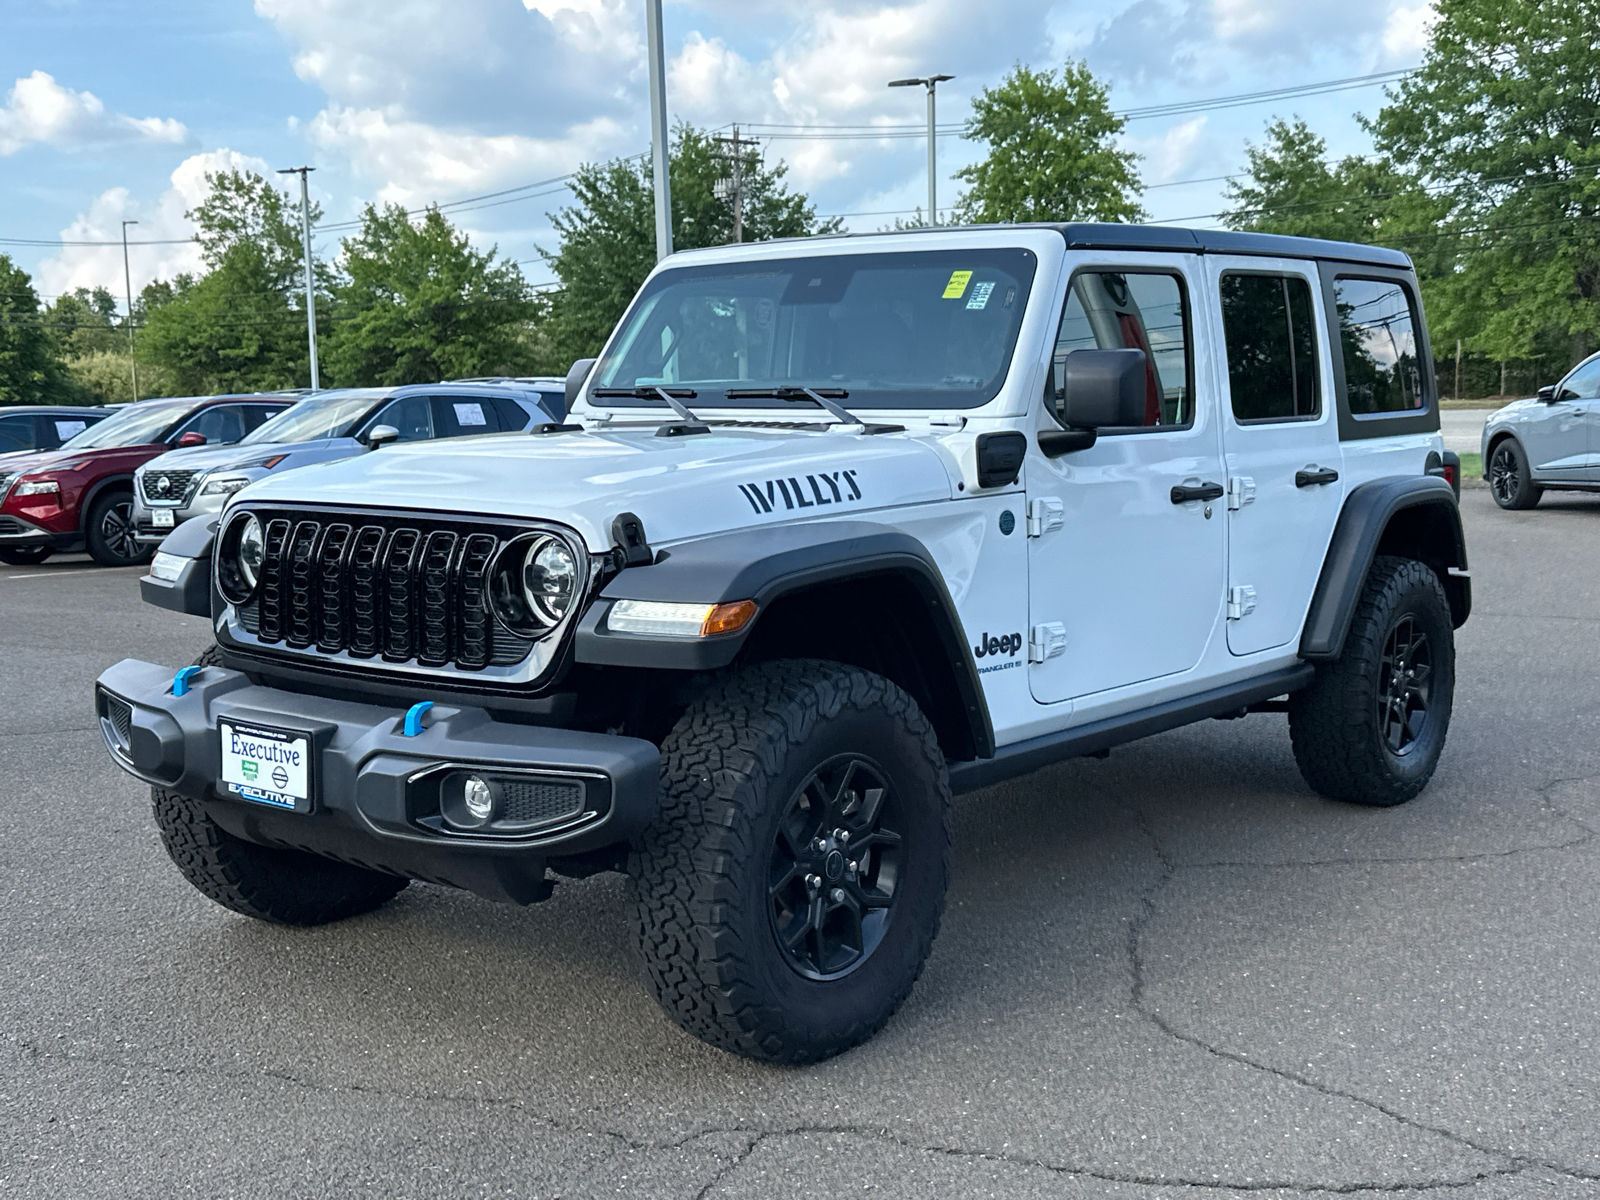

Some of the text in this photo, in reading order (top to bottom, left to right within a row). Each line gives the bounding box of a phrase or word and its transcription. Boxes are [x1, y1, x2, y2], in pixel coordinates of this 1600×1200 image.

[737, 470, 862, 514] WILLYS
[975, 632, 1022, 658] Jeep
[231, 733, 300, 766] Executive
[228, 783, 295, 805] EXECUTIVE
